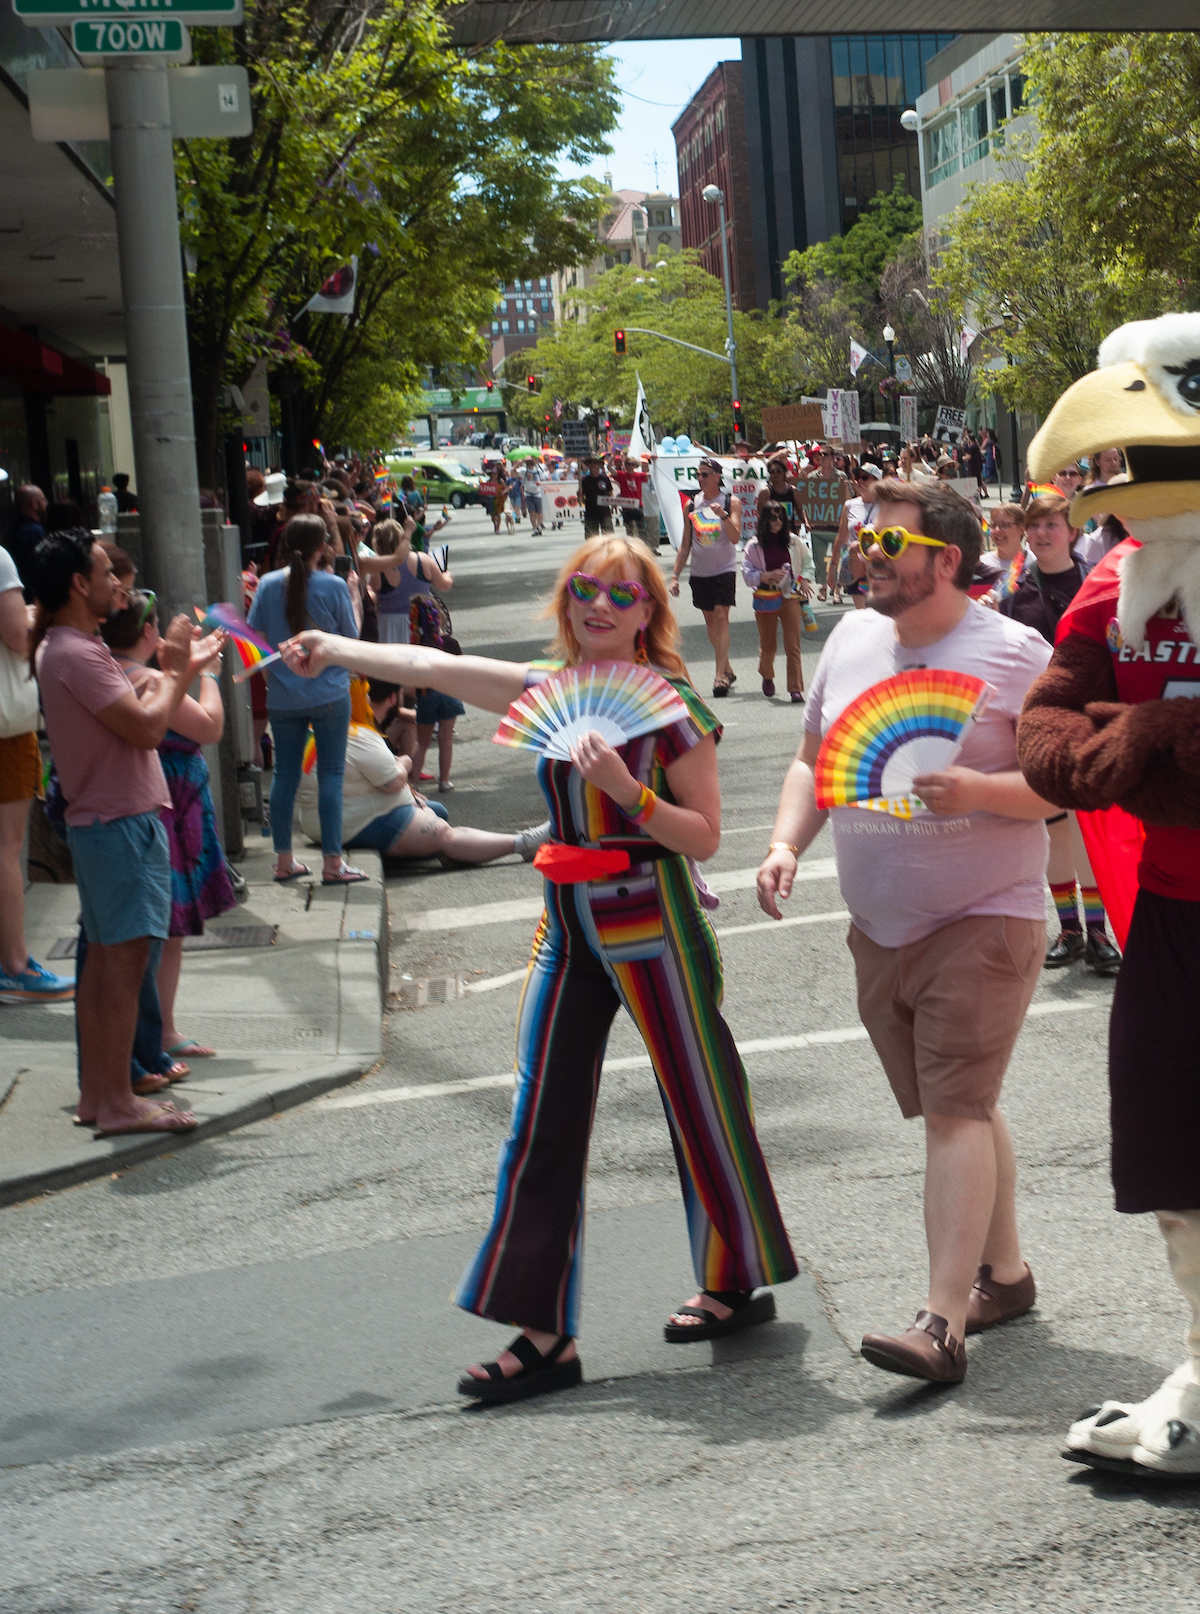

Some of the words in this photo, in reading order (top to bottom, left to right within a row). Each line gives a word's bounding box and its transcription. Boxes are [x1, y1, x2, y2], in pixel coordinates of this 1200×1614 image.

[89, 23, 167, 50] 700W
[831, 391, 840, 436] VOTE
[940, 406, 965, 421] FREE
[481, 485, 497, 493] LOVE
[733, 484, 756, 494] END
[853, 821, 901, 836] SPOKANE
[904, 821, 940, 837] PRIDE
[943, 818, 971, 833] 2024
